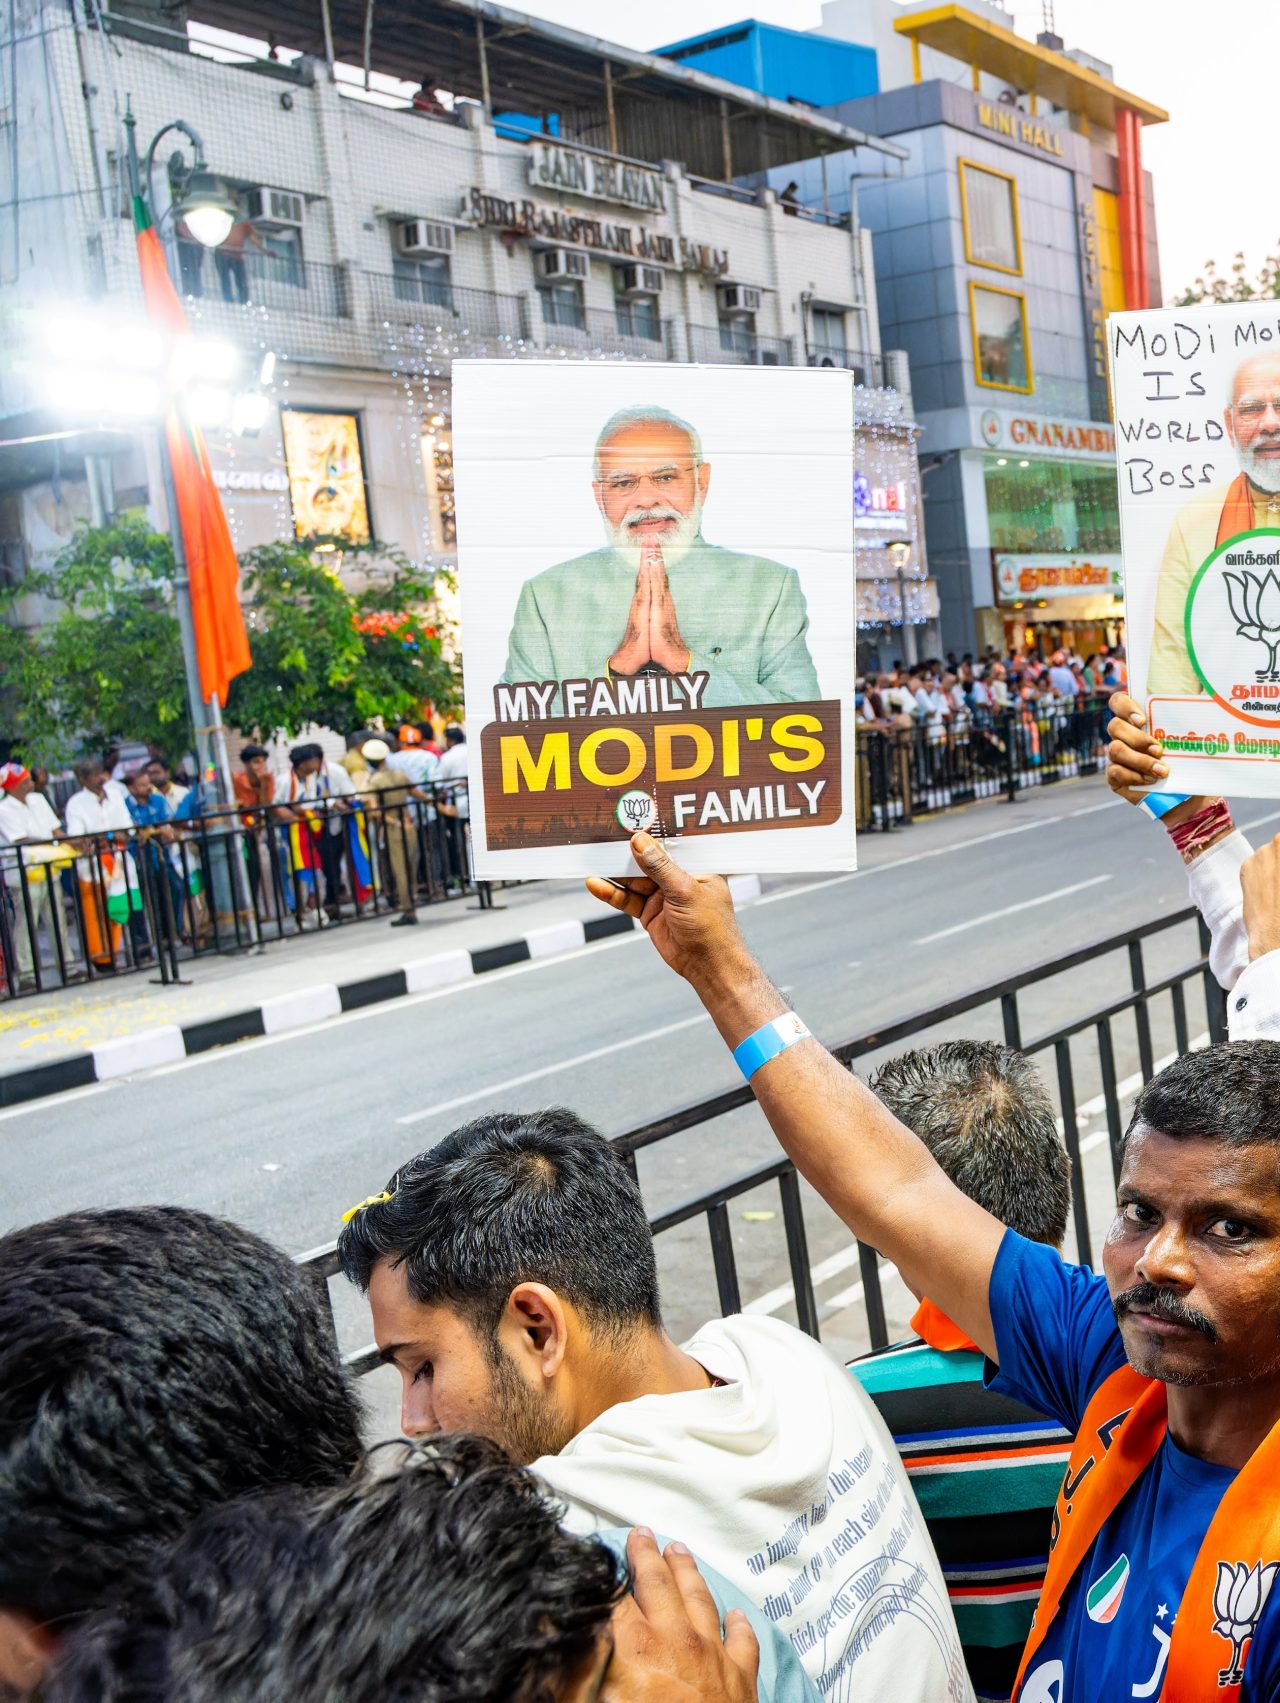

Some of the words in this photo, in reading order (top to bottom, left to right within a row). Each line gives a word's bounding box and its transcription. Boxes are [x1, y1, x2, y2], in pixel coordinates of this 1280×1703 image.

[978, 102, 1016, 137] MINI
[1021, 121, 1063, 157] HALL
[1143, 371, 1206, 401] IS
[498, 685, 555, 722] MY
[567, 675, 706, 718] FAMILY
[500, 714, 826, 794] MODI'S
[1234, 732, 1280, 758] மோடி
[673, 780, 827, 828] FAMILY
[747, 1553, 766, 1577] an
[828, 1471, 856, 1495] the
[762, 1592, 793, 1622] ding
[788, 1564, 814, 1605] about
[831, 1518, 867, 1557] each
[861, 1498, 881, 1530] side
[790, 1621, 818, 1658] hich
[830, 1595, 856, 1619] the
